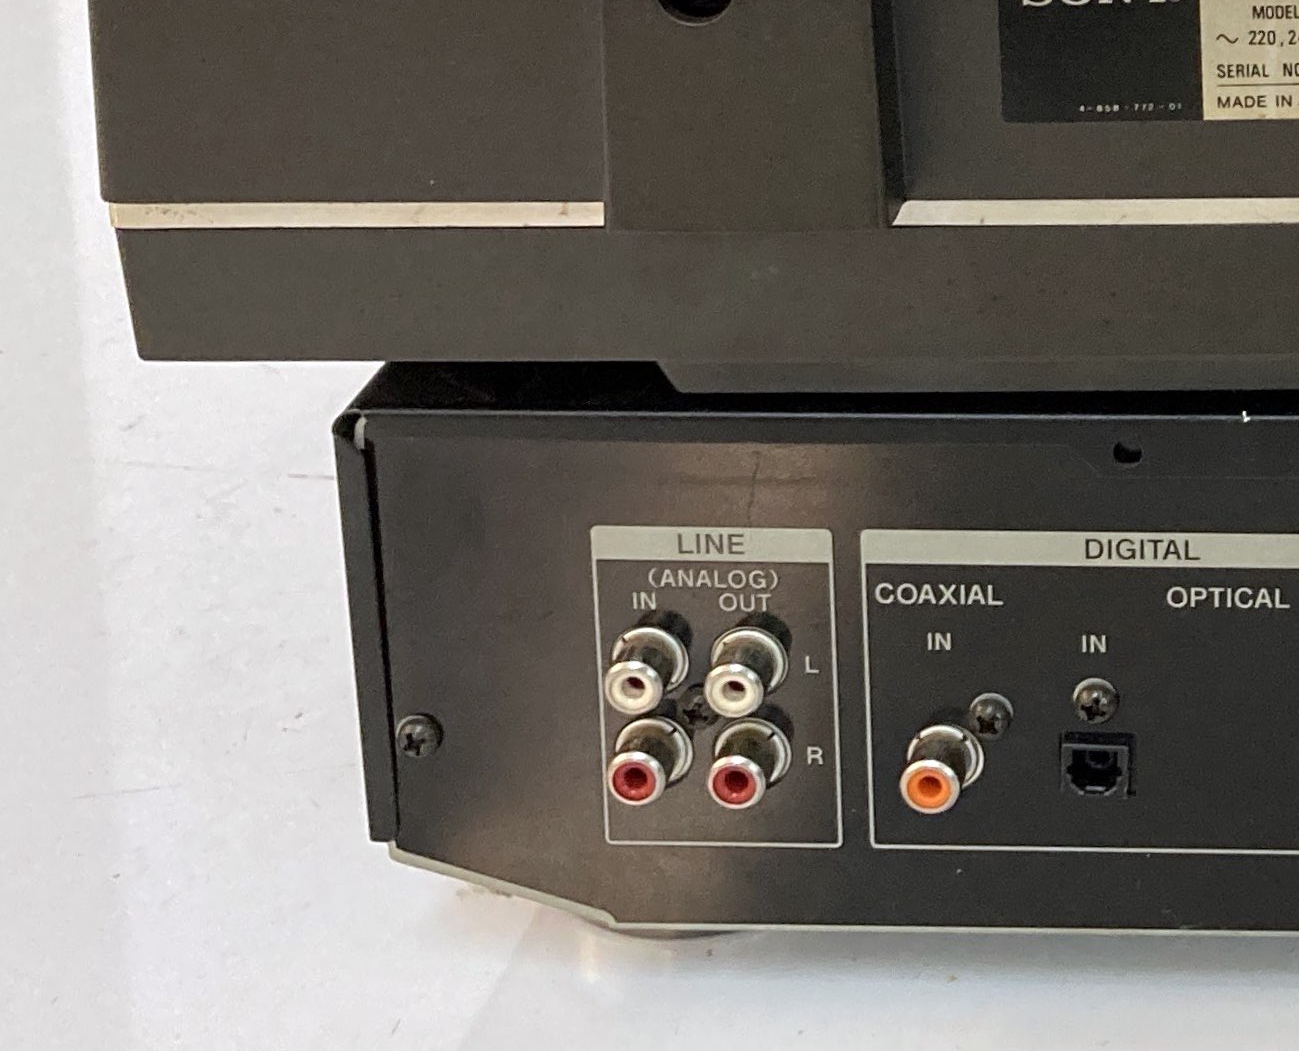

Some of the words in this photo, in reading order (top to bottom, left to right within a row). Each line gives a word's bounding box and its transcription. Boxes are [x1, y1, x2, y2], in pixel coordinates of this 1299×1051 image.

[1216, 62, 1269, 79] SERIAL
[1216, 95, 1268, 110] MADE
[1275, 94, 1295, 109] IN
[676, 532, 745, 556] LINE
[1084, 538, 1201, 562] DIGITAL
[647, 569, 779, 592] (ANALOG)
[632, 592, 657, 612] IN
[718, 592, 772, 613] OUT
[874, 584, 1004, 608] COAXIAL
[1166, 586, 1290, 610] OPTICAL
[927, 632, 952, 652] IN
[1081, 634, 1106, 655] IN
[805, 656, 819, 676] L
[806, 746, 824, 765] R
